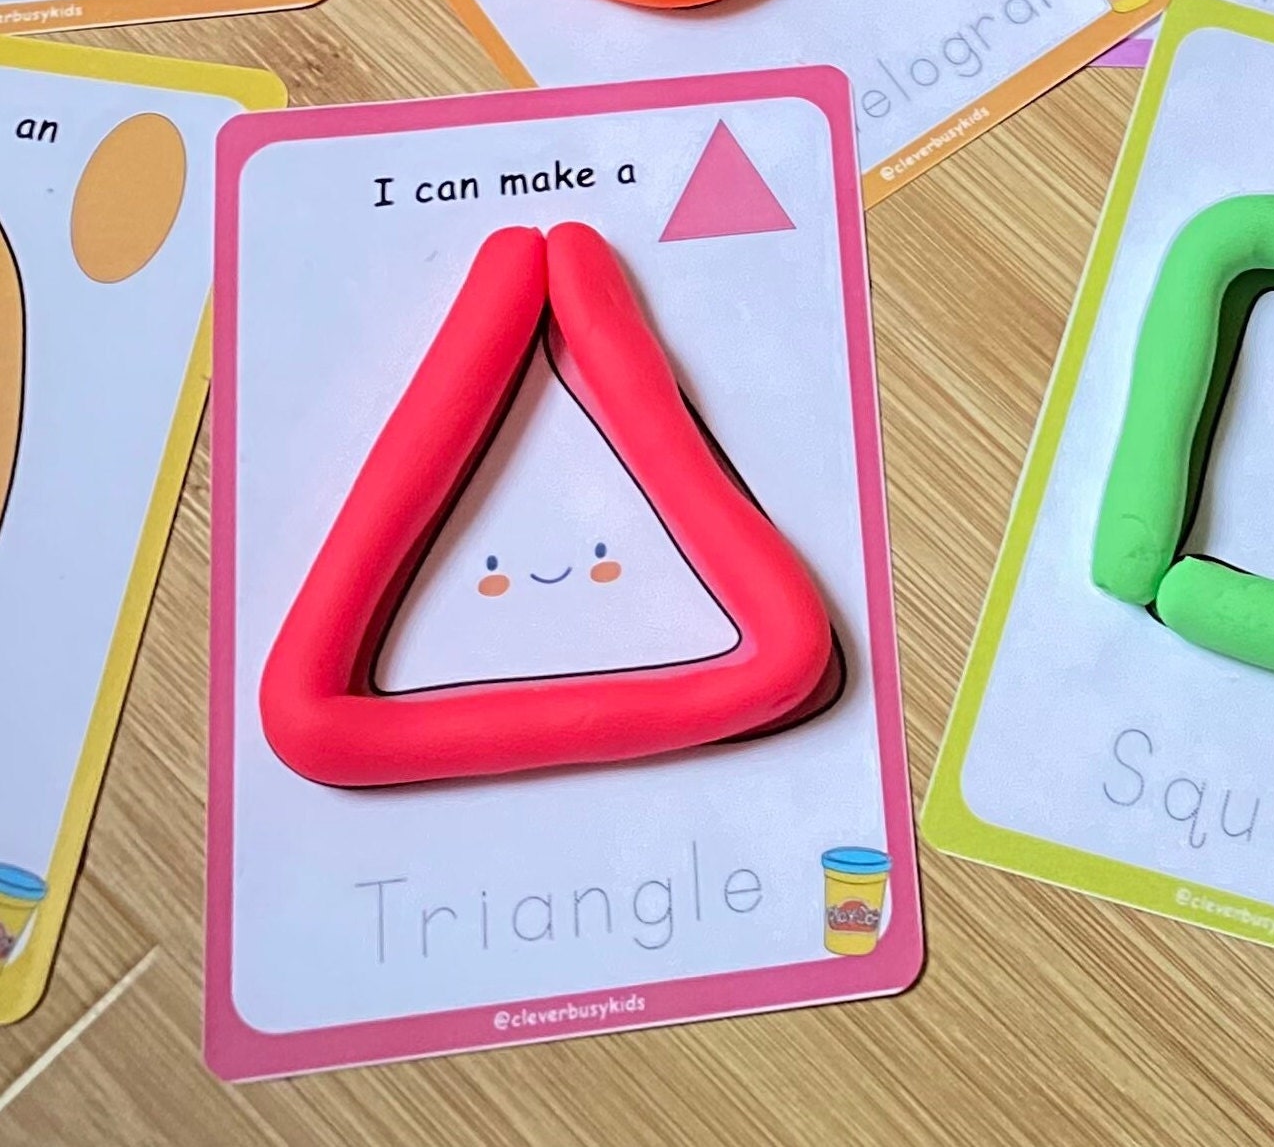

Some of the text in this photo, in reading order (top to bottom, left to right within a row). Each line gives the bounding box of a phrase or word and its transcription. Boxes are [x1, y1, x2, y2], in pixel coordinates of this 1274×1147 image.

[17, 119, 57, 142] an
[880, 105, 991, 181] @cleverbusykids
[375, 161, 635, 206] I can make a
[355, 840, 765, 965] Triangle
[493, 993, 646, 1031] @cleverbusykids
